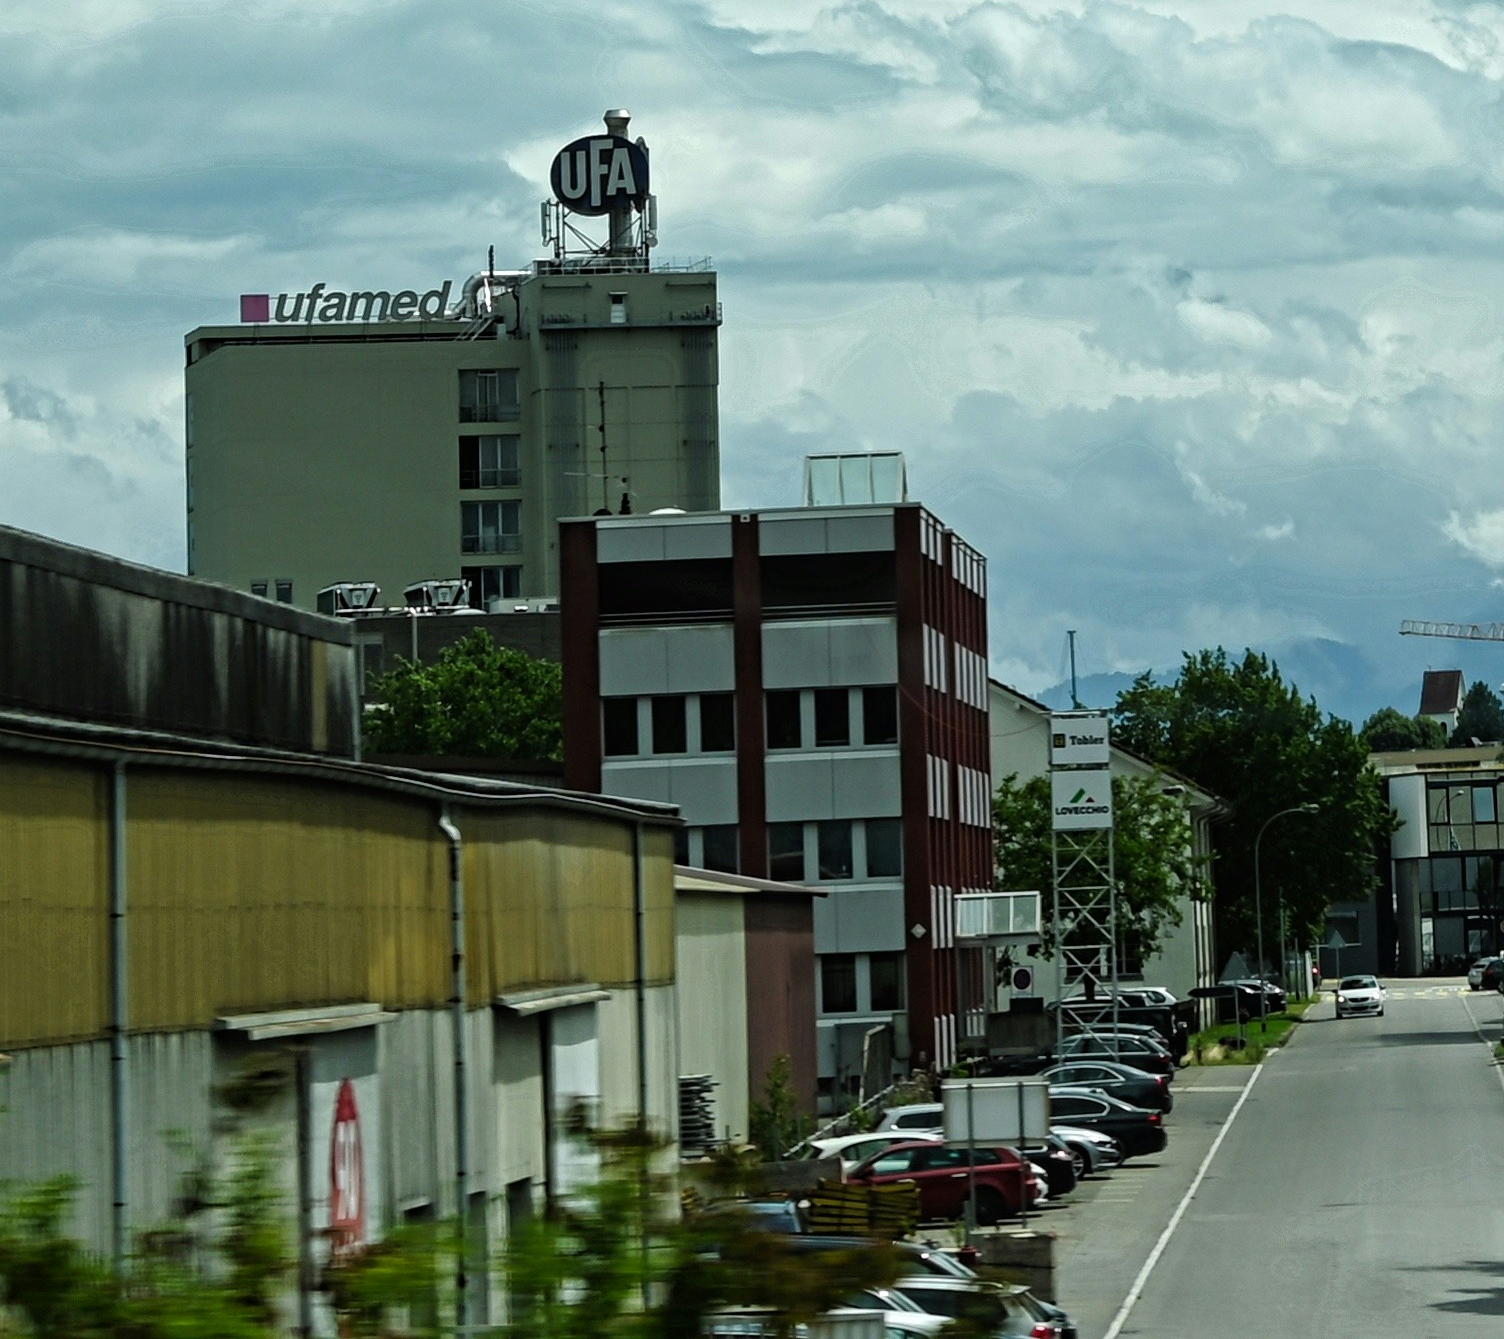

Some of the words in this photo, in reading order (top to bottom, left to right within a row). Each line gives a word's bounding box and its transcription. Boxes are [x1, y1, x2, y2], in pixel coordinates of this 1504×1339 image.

[560, 138, 637, 207] UFA
[274, 280, 453, 322] ufamed
[1069, 735, 1105, 746] Tobler
[1055, 805, 1110, 816] LOVECCHIO
